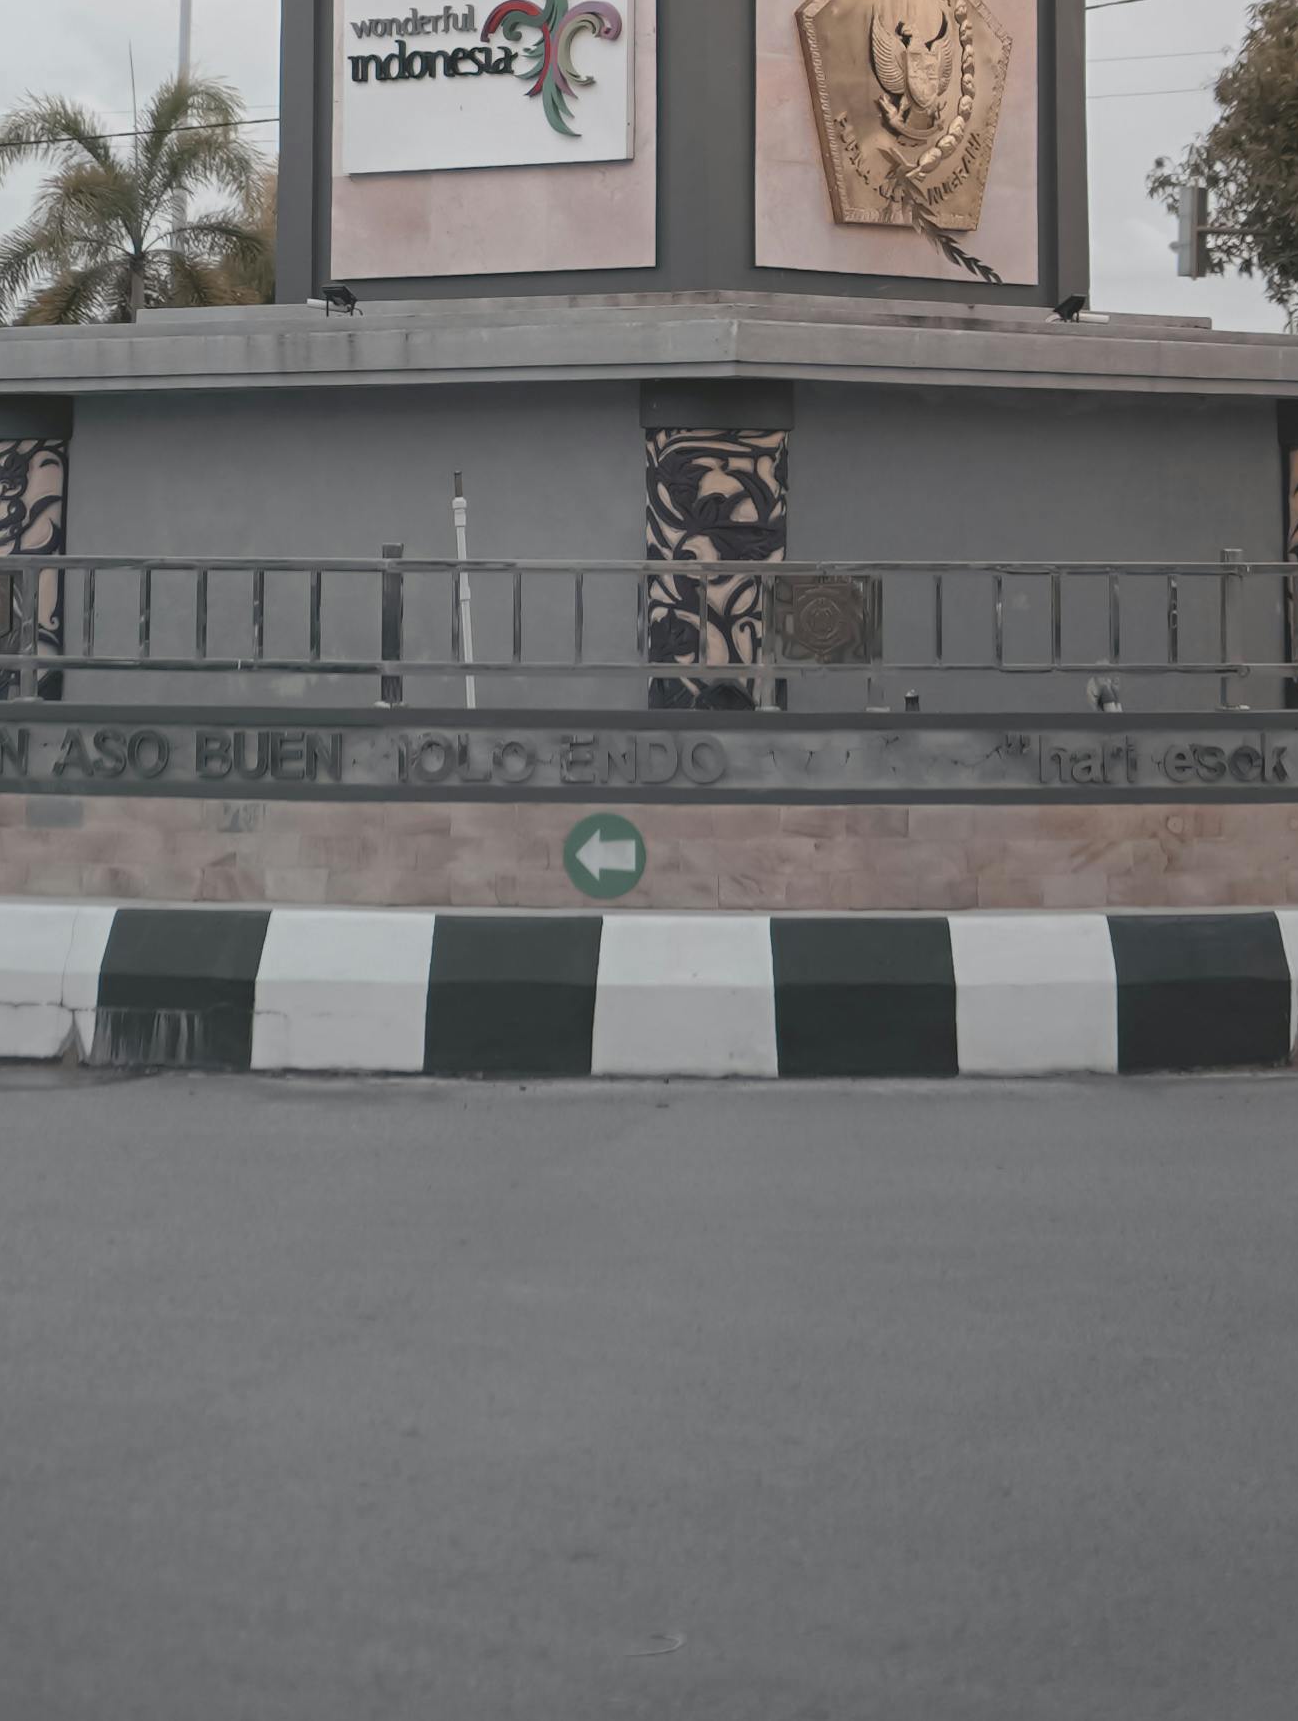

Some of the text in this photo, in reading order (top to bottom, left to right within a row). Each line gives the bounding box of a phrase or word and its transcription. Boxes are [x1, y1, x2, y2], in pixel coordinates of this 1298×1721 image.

[350, 4, 478, 39] wonderful
[348, 39, 519, 82] indonesia
[52, 727, 170, 779] ASO
[195, 730, 343, 782] BUEN
[1163, 733, 1288, 783] esok
